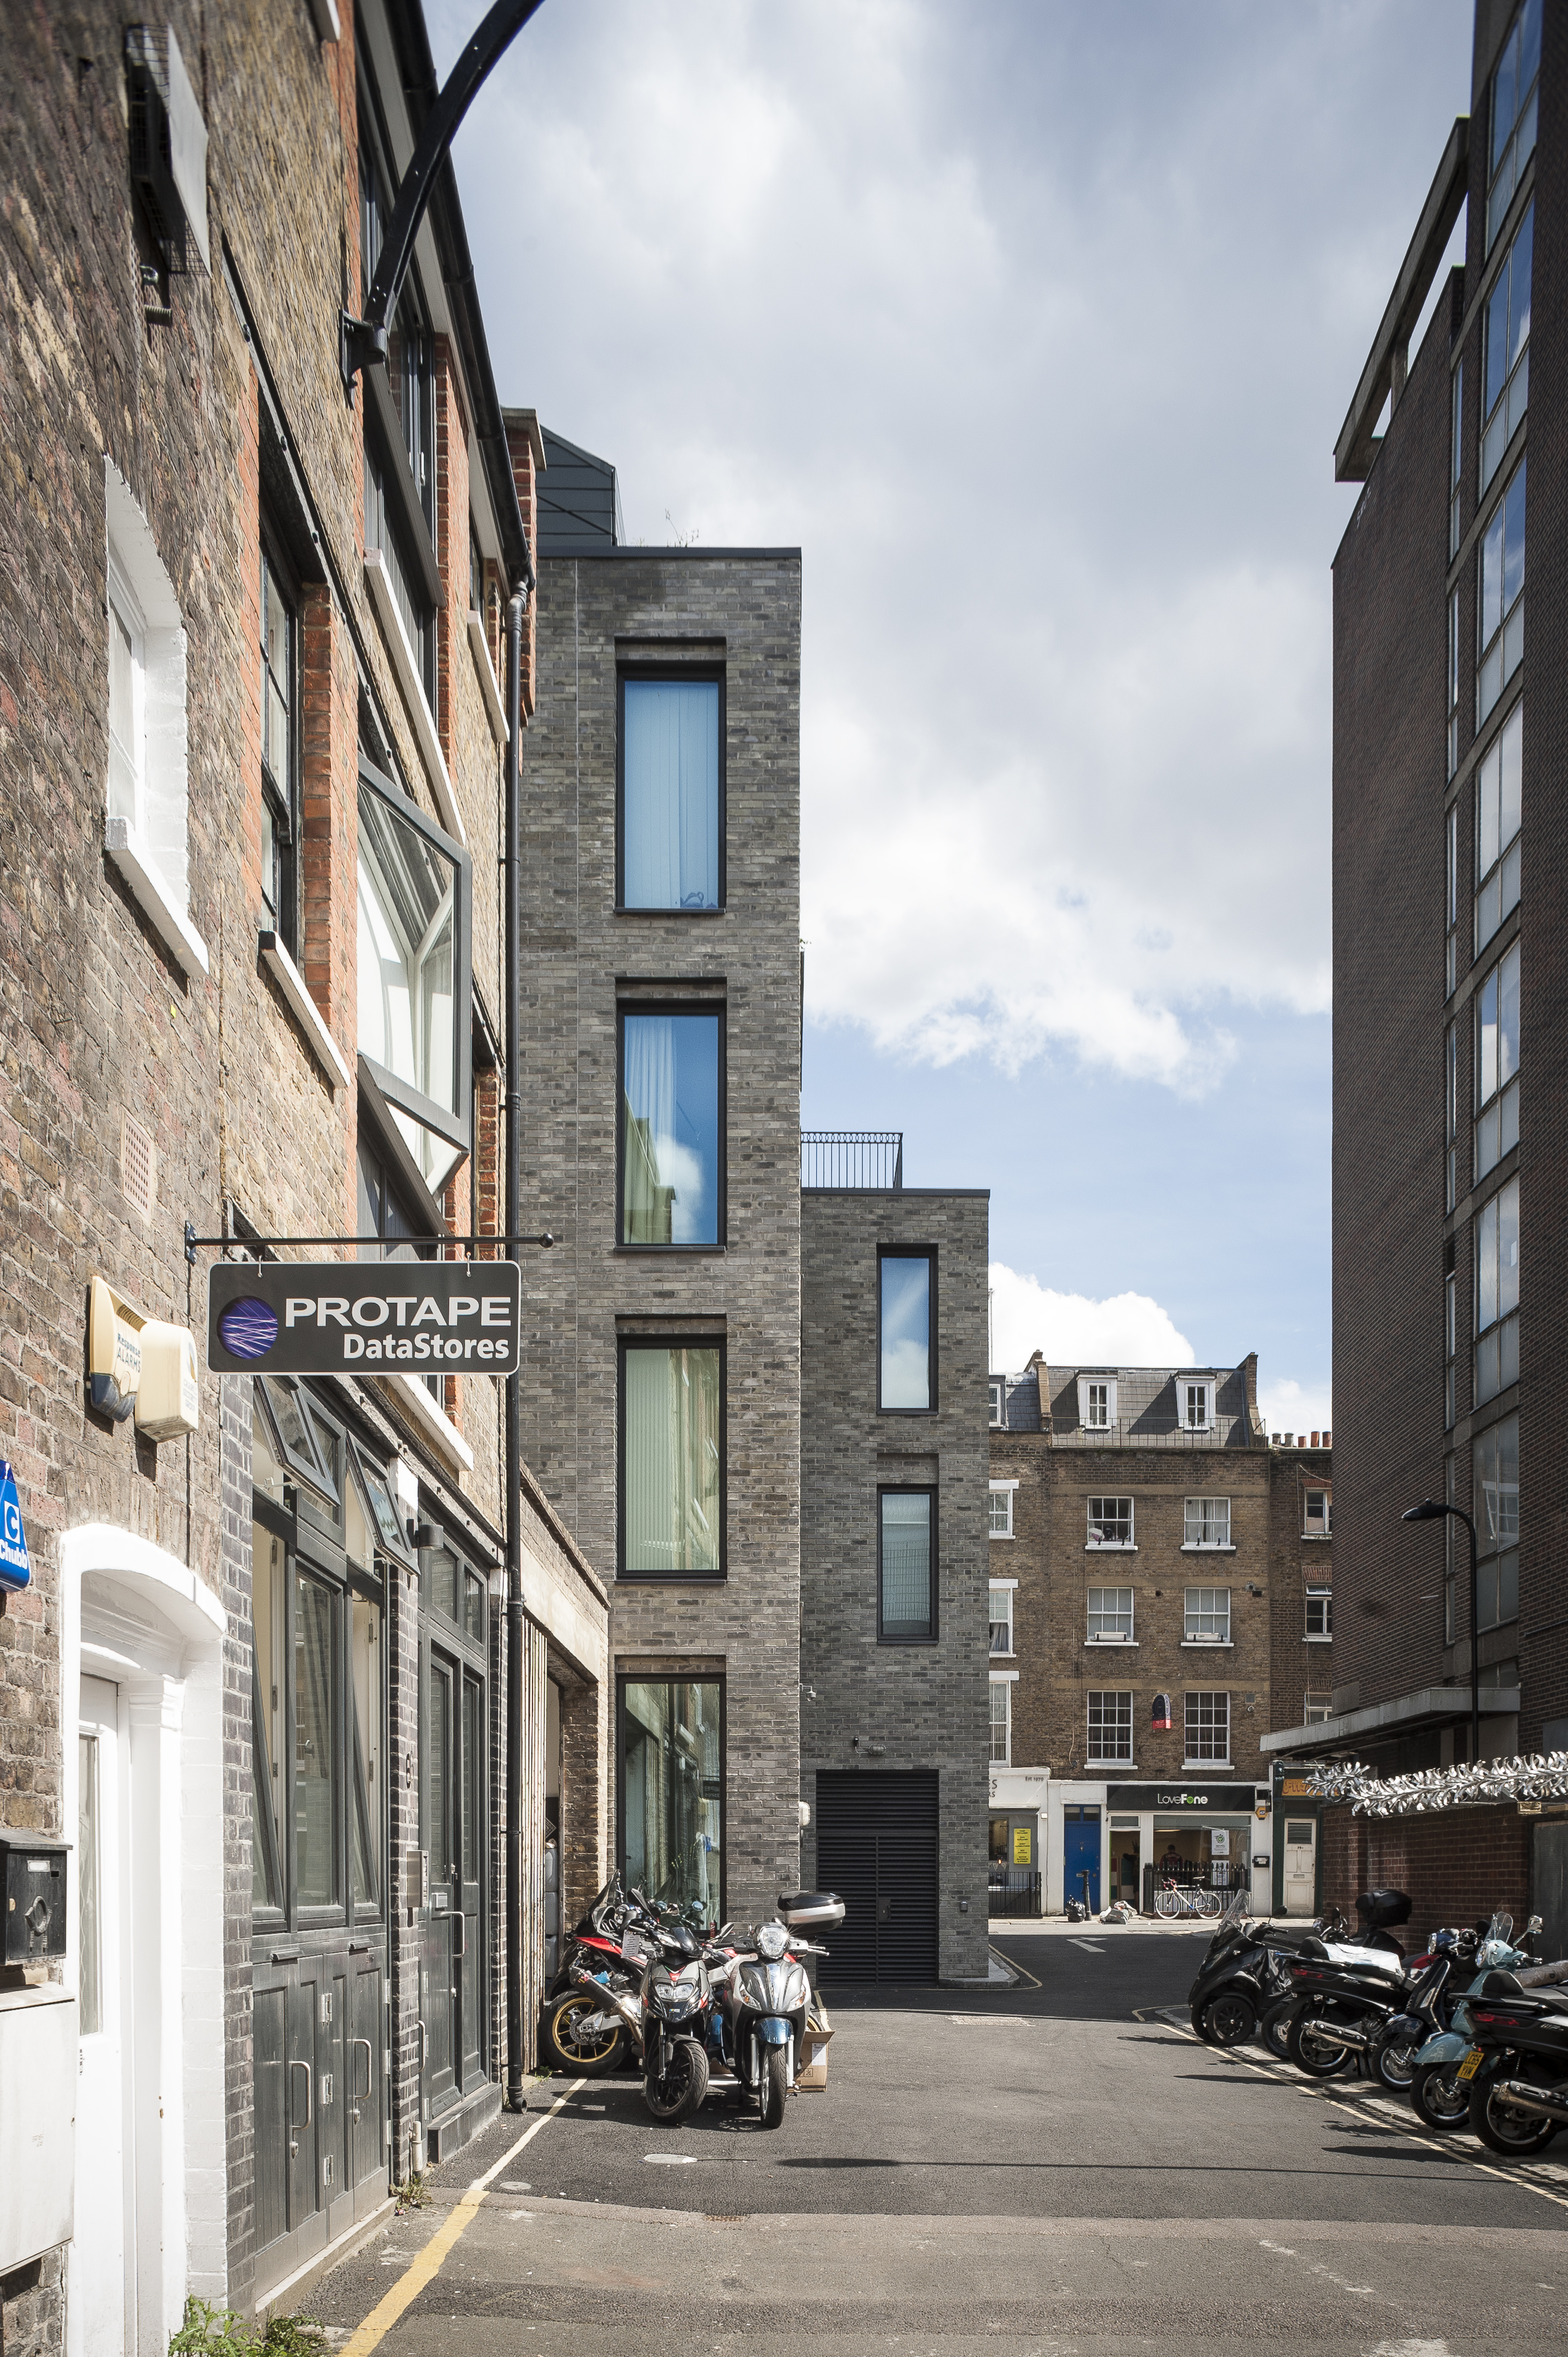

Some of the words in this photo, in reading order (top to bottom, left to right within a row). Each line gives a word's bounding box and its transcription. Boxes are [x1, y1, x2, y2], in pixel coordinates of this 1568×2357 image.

[286, 1297, 511, 1327] PROTAPE
[344, 1333, 509, 1359] DataStores
[117, 1347, 140, 1373] ALARMS
[0, 1539, 28, 1570] Chubb
[1157, 1793, 1208, 1804] LoveFone
